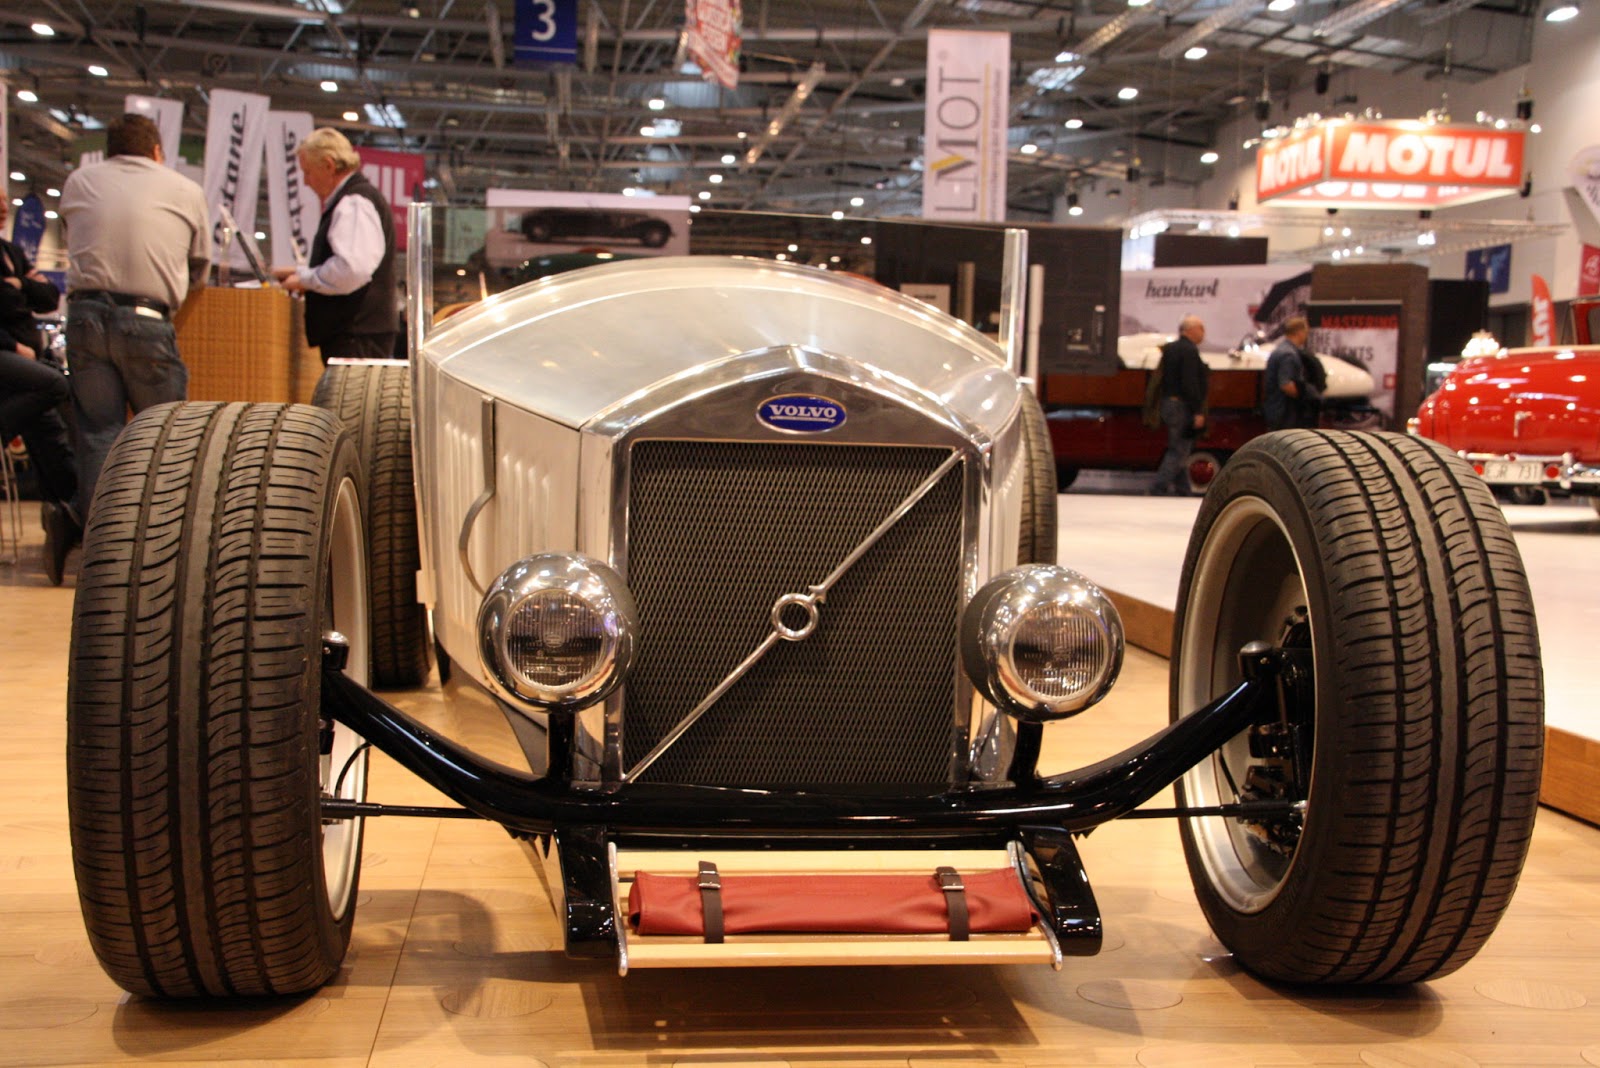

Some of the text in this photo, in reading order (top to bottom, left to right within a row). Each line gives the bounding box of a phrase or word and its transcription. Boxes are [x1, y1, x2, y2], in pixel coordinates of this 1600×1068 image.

[531, 0, 557, 42] 3
[1259, 134, 1323, 193] MOTUL
[1338, 132, 1514, 179] MOTUL
[1145, 277, 1220, 299] hanhart
[1321, 314, 1399, 330] MASTERING
[768, 404, 838, 419] VOLVO
